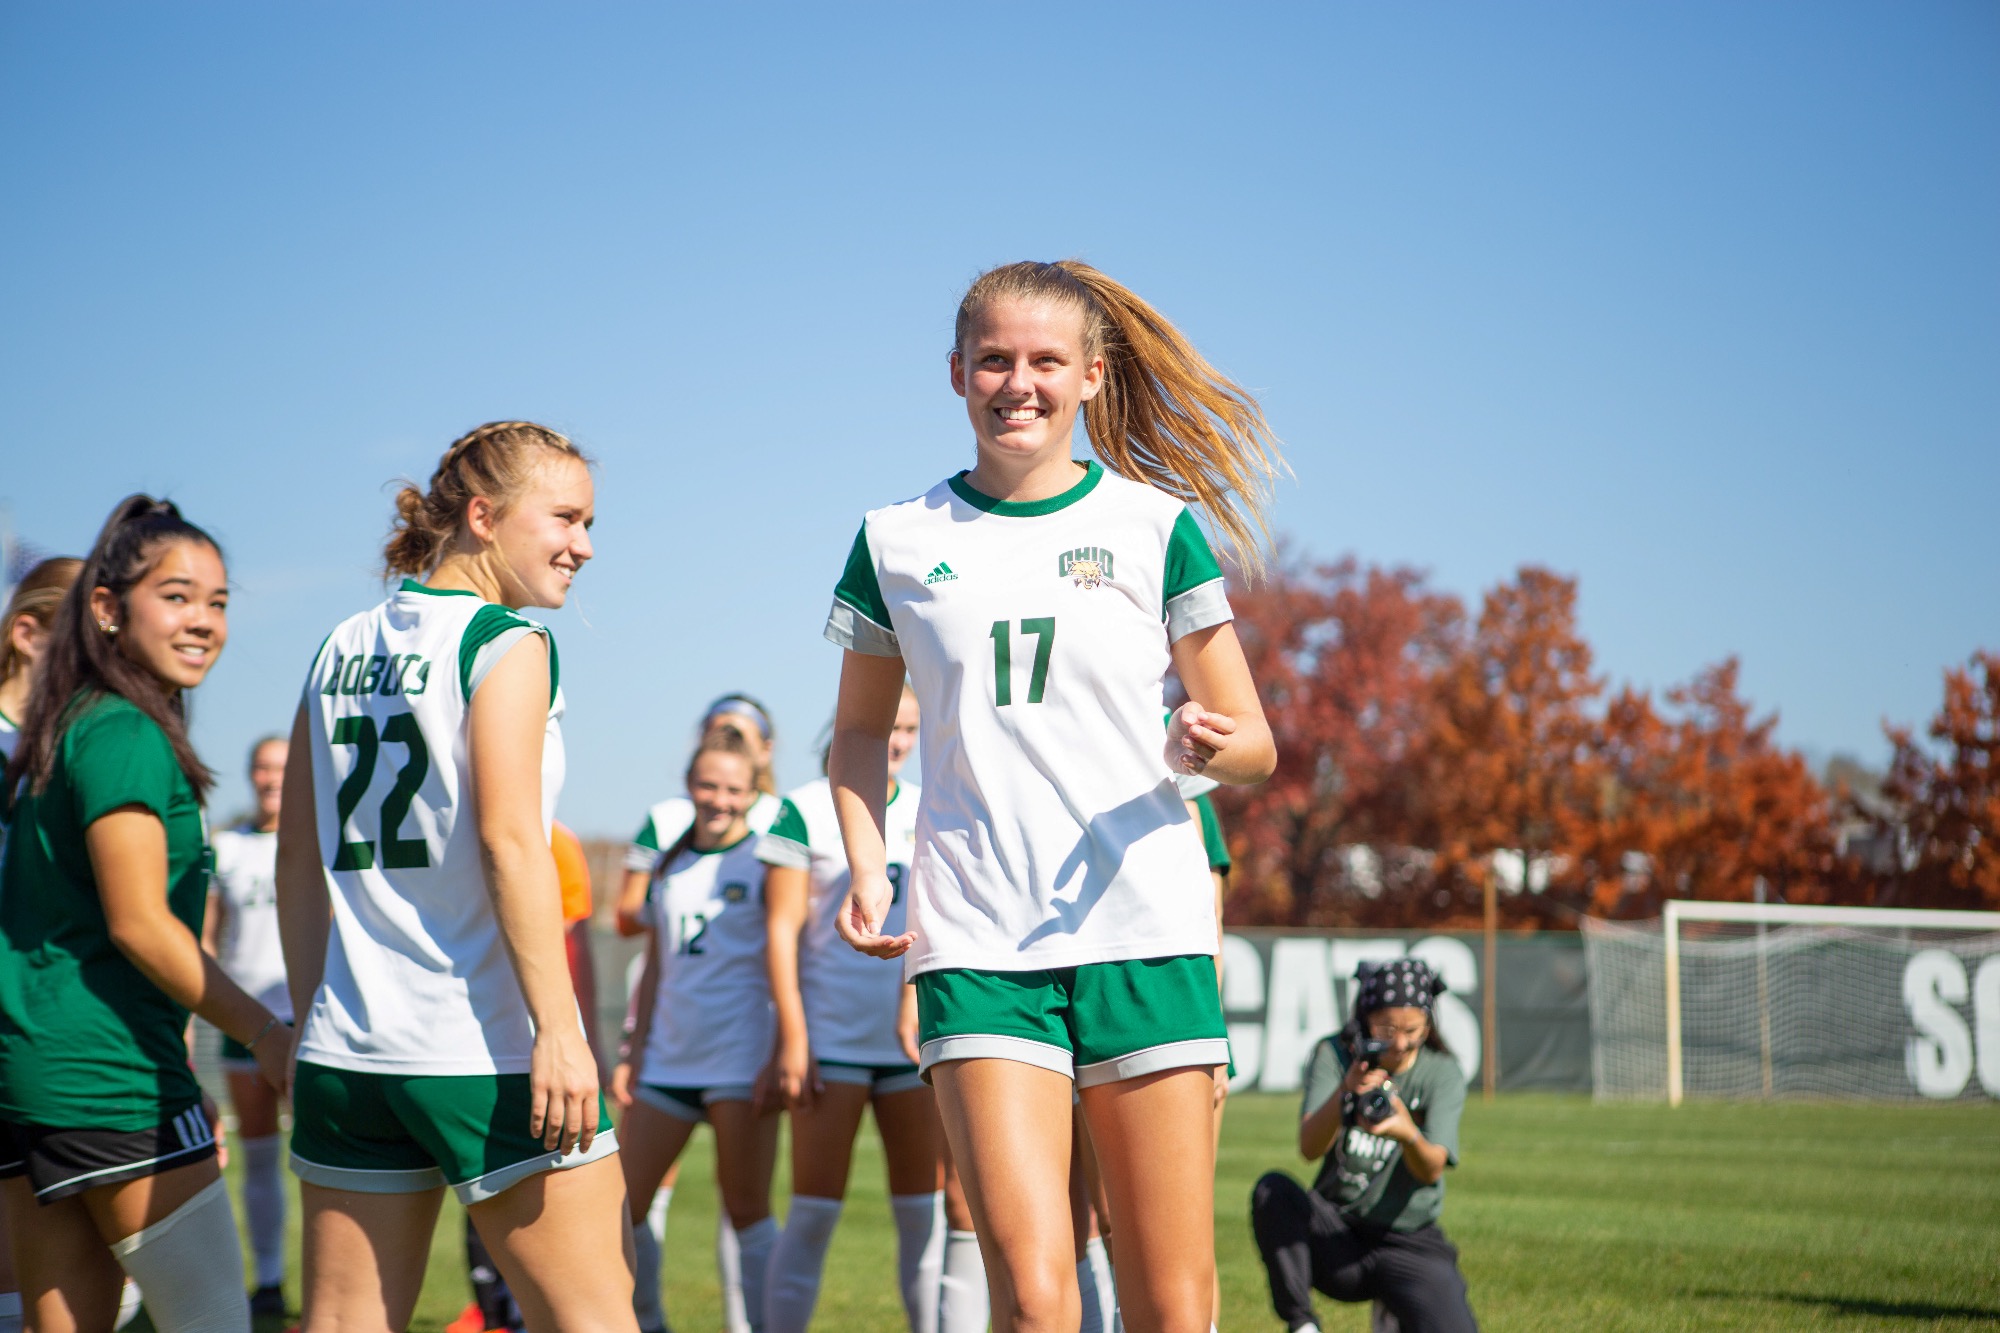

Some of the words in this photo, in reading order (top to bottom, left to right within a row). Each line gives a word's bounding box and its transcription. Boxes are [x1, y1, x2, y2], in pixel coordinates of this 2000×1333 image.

[923, 571, 958, 586] adidas
[1058, 546, 1115, 580] OHIO
[988, 616, 1056, 707] 17
[331, 712, 430, 872] 22
[680, 913, 708, 955] 12
